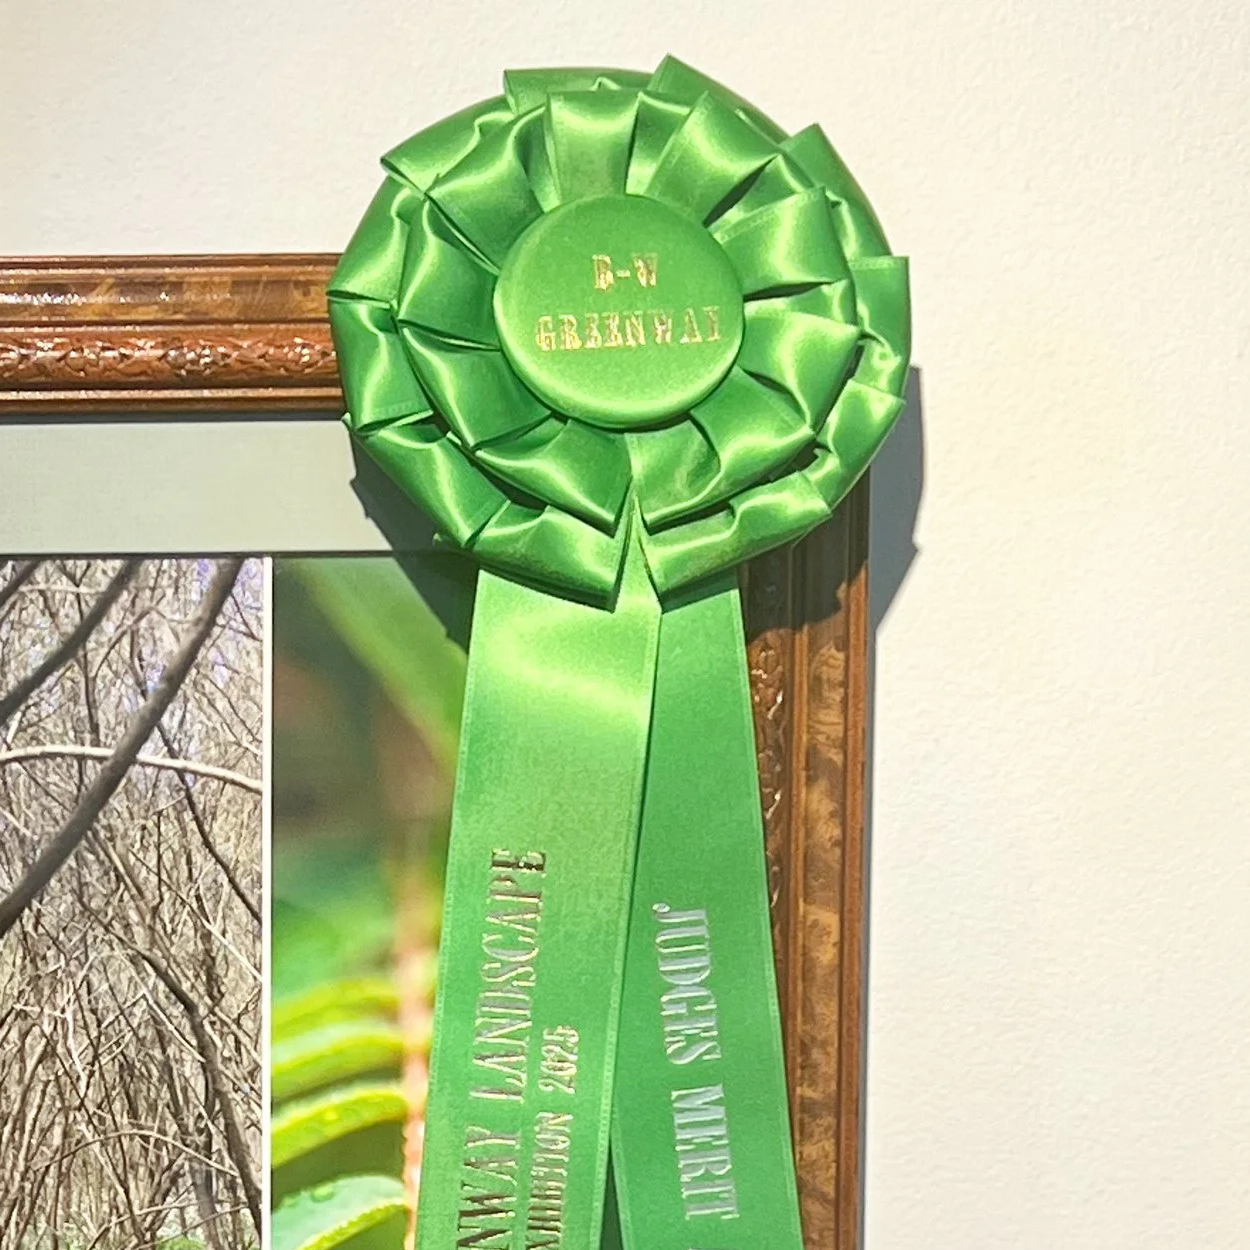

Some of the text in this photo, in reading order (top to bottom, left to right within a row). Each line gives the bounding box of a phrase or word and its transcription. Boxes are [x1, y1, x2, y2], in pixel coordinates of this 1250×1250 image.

[592, 252, 659, 290] B-W
[469, 847, 548, 1104] LANDSCAPE
[651, 902, 724, 1066] JUDGES
[538, 1023, 581, 1096] 2025
[670, 1082, 740, 1222] MERIT
